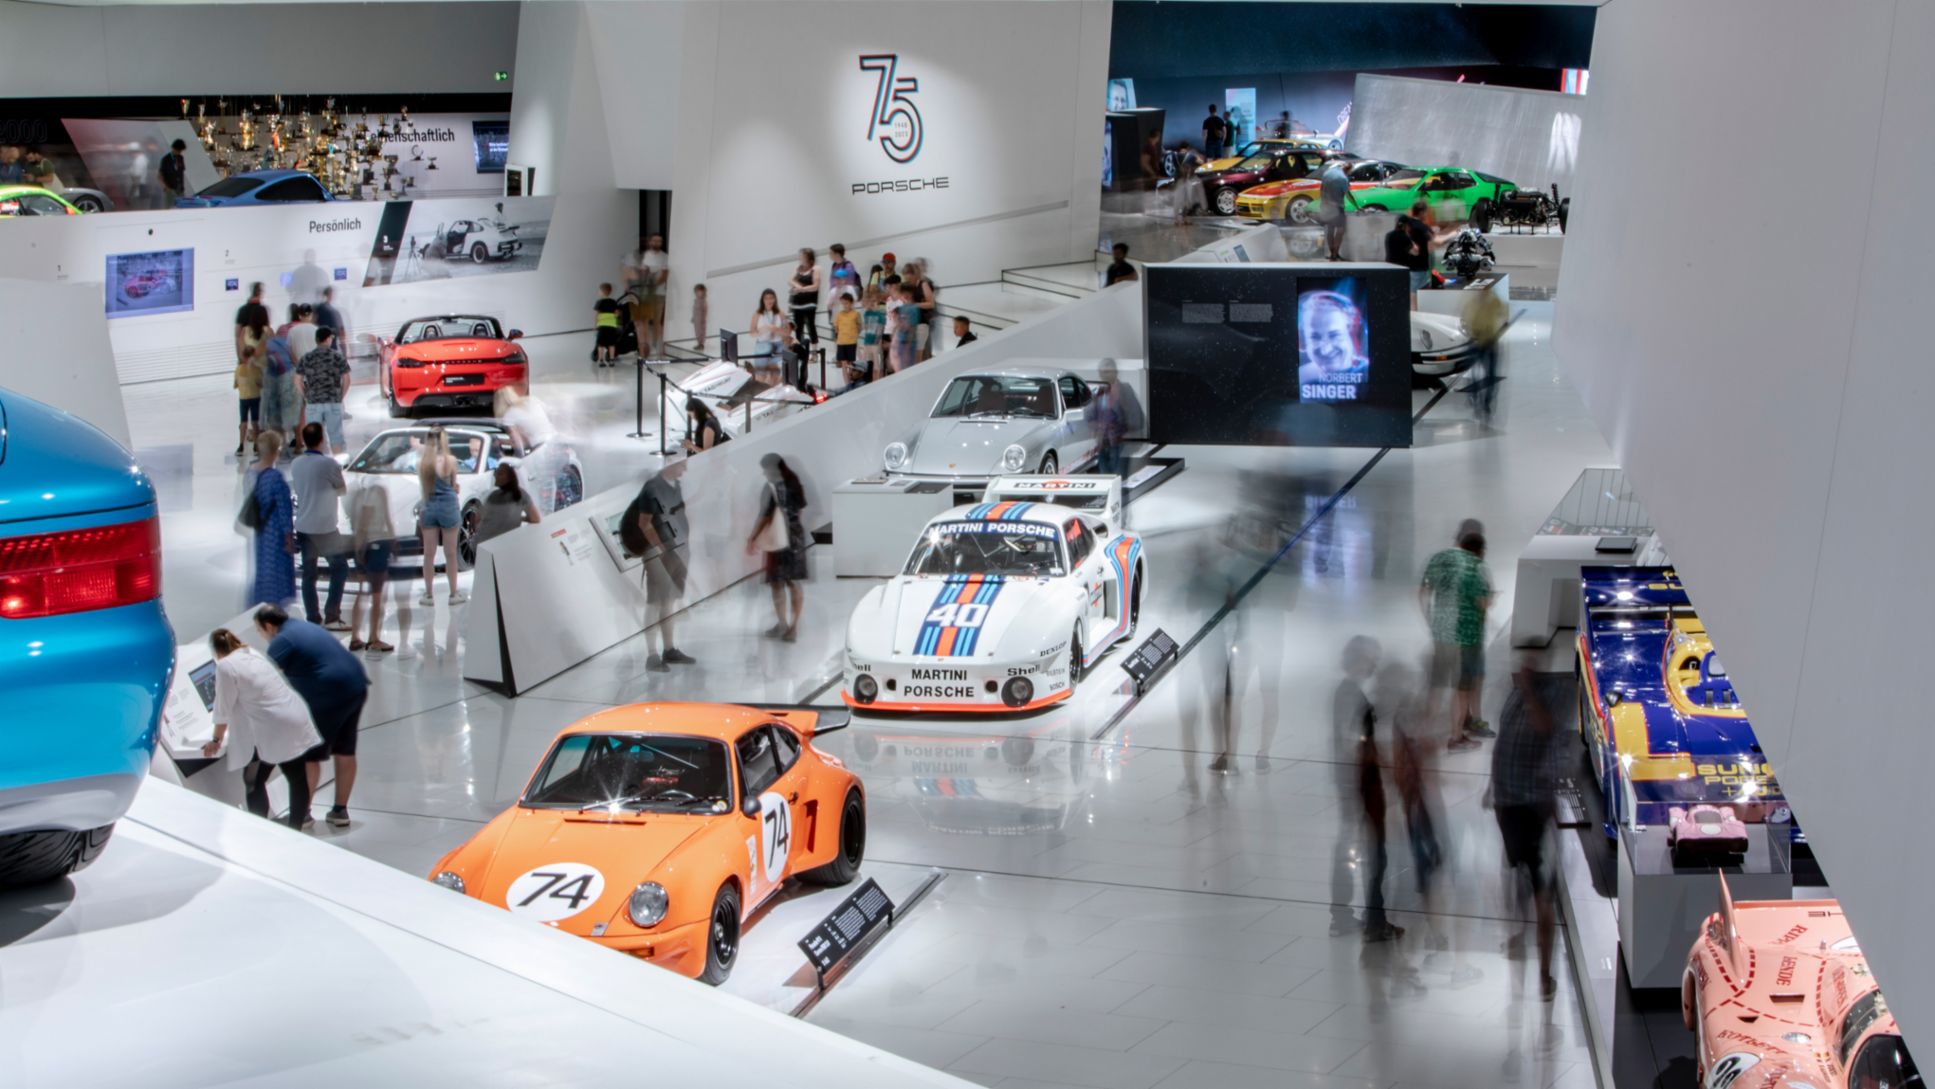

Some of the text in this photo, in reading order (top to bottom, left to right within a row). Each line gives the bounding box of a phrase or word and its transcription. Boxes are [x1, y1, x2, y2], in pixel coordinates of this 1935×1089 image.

[859, 54, 923, 163] 75
[852, 177, 949, 195] PORSCHE
[309, 217, 361, 233] Persönlich
[1319, 372, 1363, 383] NORBERT
[1302, 384, 1357, 399] SINGER
[987, 522, 1056, 539] PORSCHE
[926, 603, 990, 627] 40
[911, 669, 968, 680] MARTINI
[1007, 664, 1040, 676] Shell
[904, 686, 975, 697] PORSCHE
[765, 800, 789, 869] 74
[516, 872, 595, 909] 74
